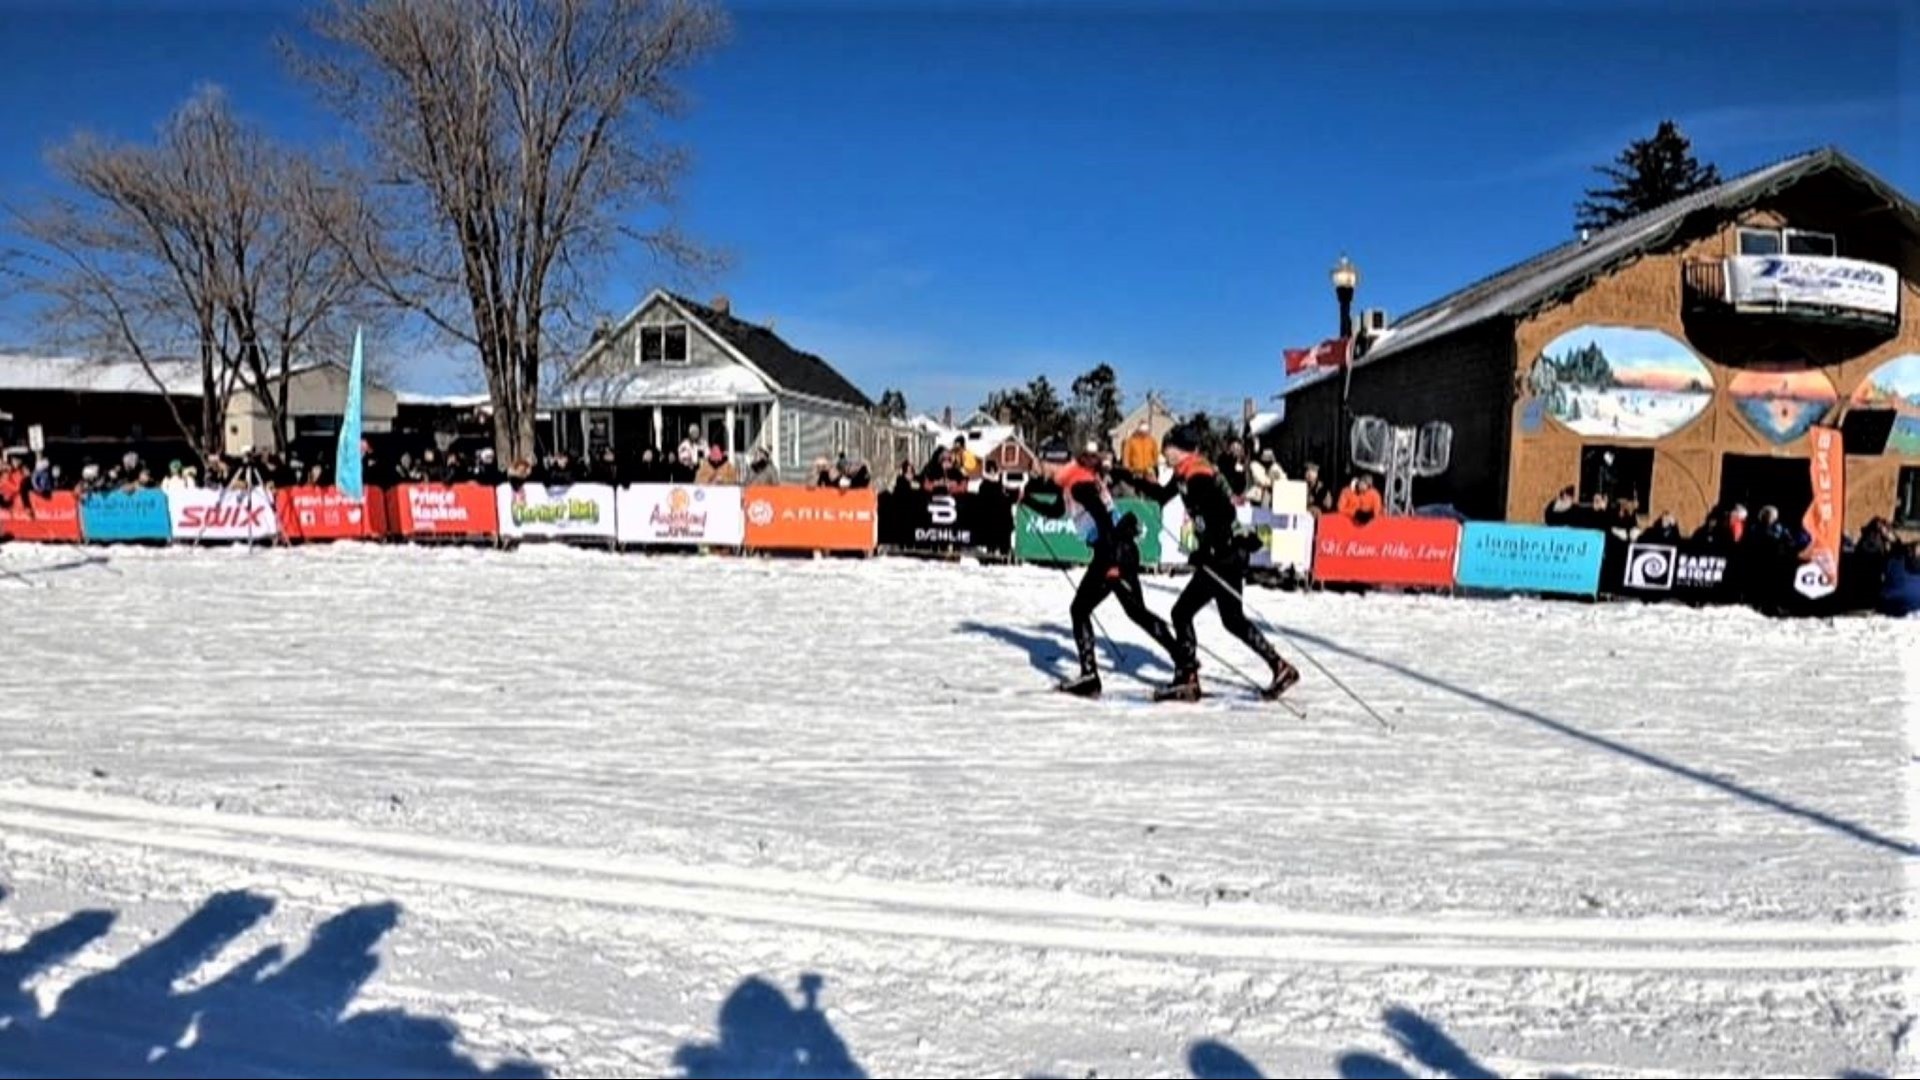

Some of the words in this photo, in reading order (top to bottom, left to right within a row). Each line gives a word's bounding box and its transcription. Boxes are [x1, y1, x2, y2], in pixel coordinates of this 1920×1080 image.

[408, 486, 456, 505] Prince
[1679, 554, 1727, 569] EARTH
[1676, 566, 1723, 583] RIDER
